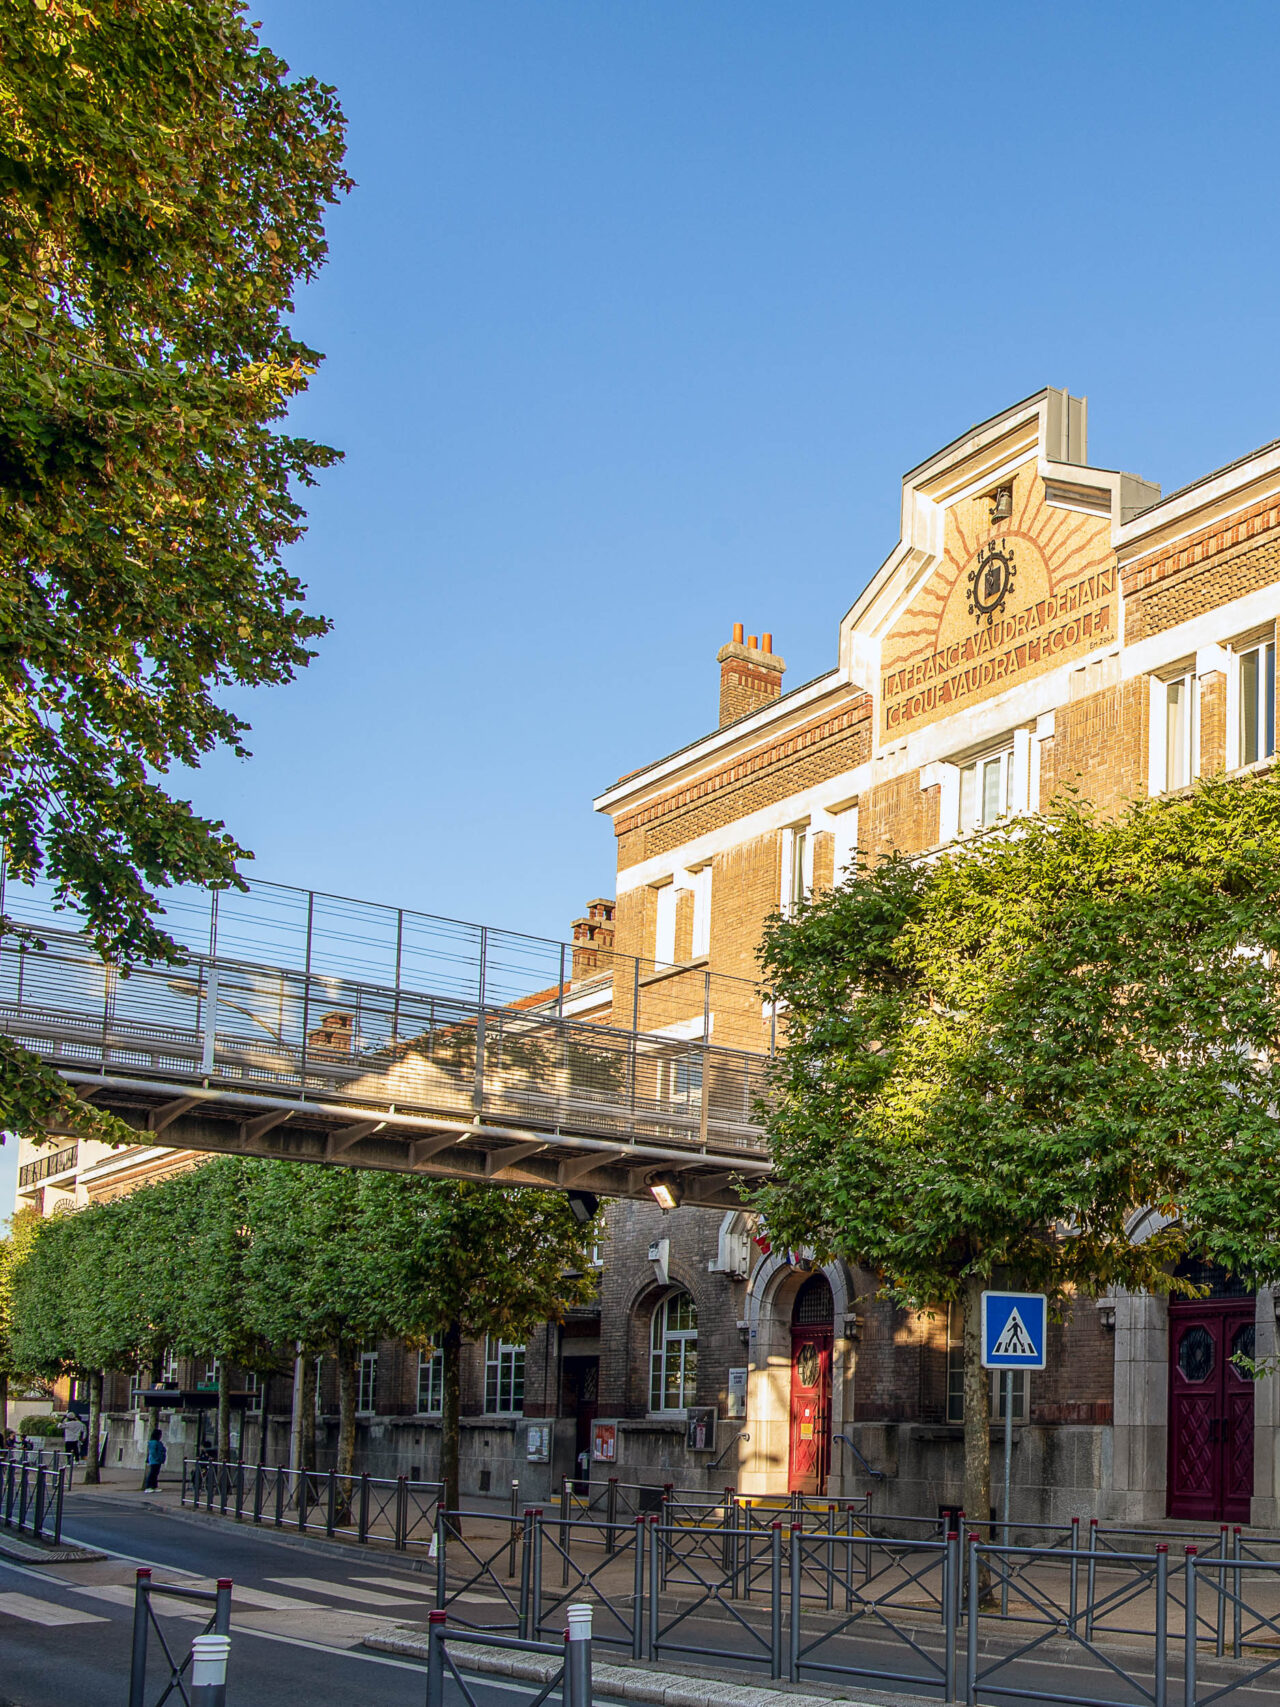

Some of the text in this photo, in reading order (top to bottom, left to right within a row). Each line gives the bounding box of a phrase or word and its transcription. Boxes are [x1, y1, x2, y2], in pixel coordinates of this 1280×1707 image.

[1002, 537, 1006, 550] 1
[1011, 564, 1017, 577] 3
[968, 603, 974, 615] 8
[975, 614, 981, 626] 7
[884, 567, 1114, 700] LA FRANCE VAUDRA DEMAIN
[888, 702, 908, 728] CE
[910, 682, 945, 716] QUE
[948, 649, 1020, 699] VAUDRA
